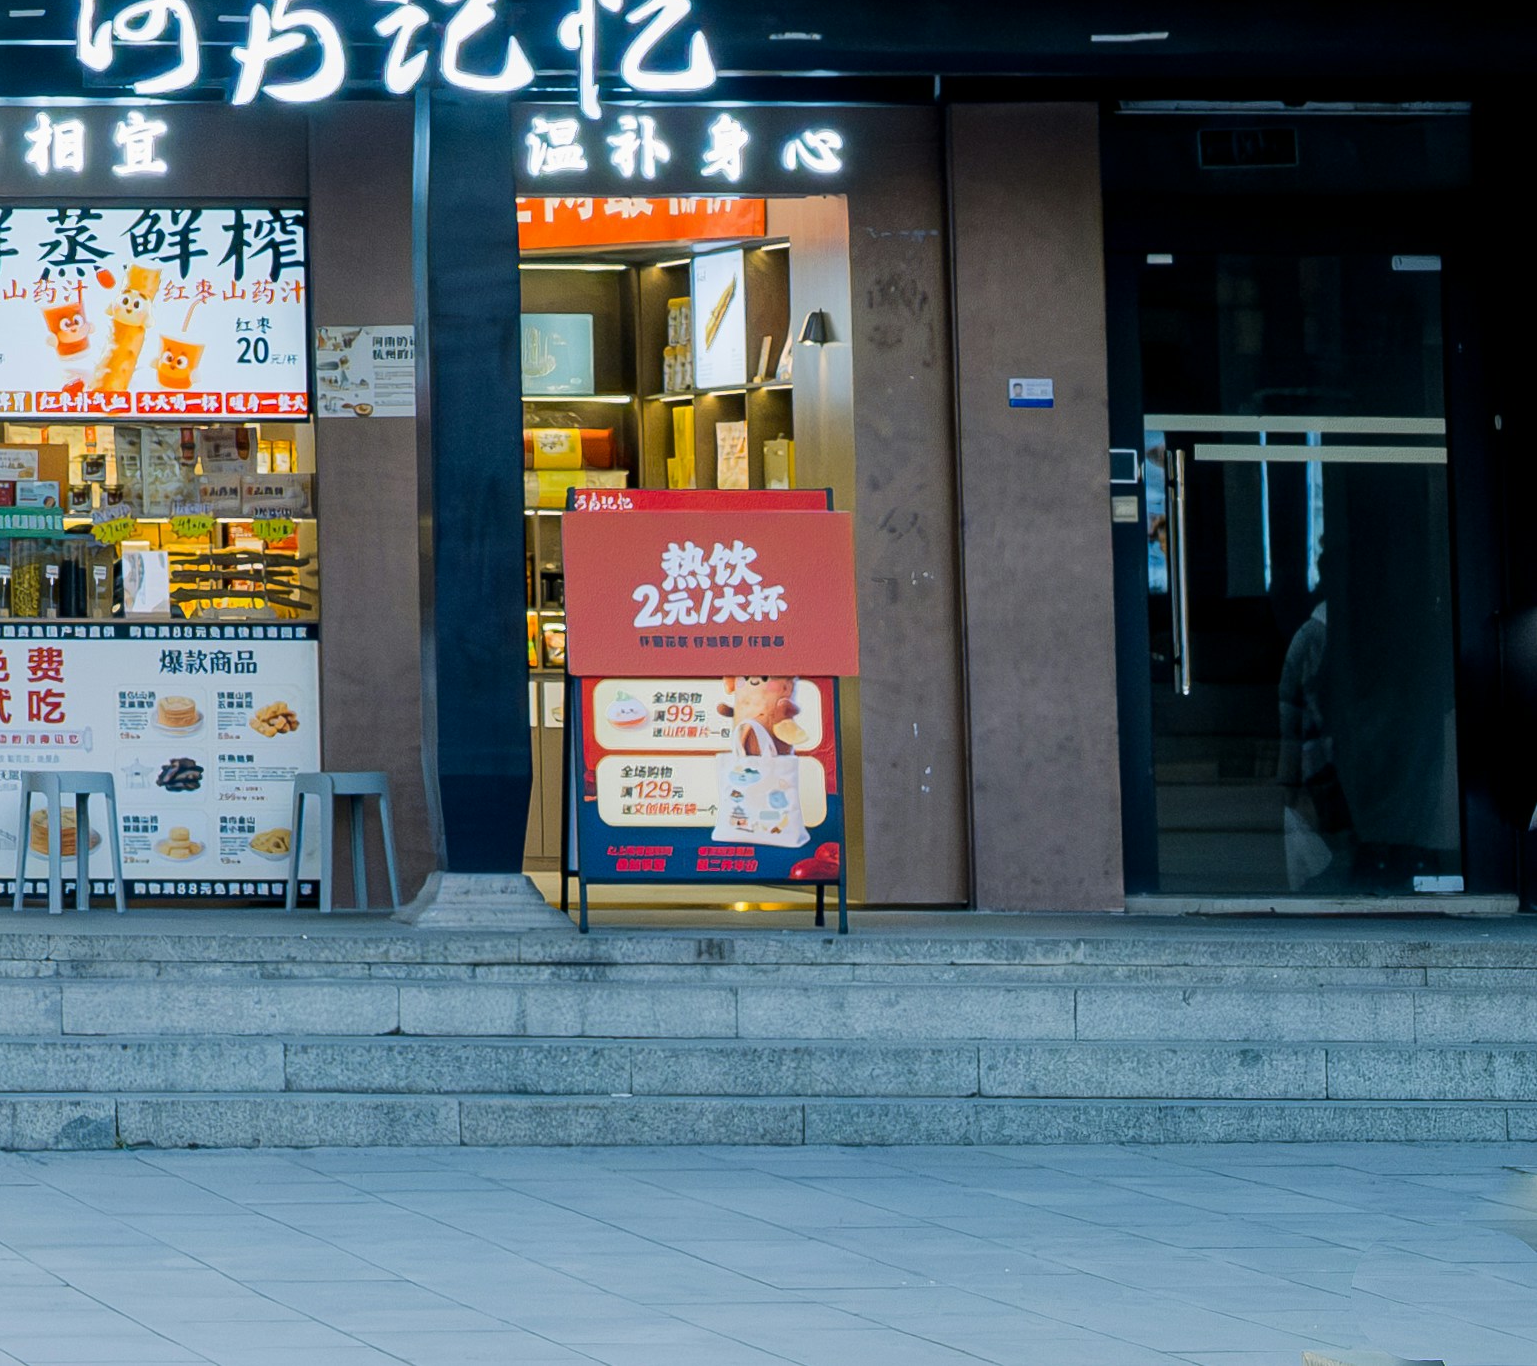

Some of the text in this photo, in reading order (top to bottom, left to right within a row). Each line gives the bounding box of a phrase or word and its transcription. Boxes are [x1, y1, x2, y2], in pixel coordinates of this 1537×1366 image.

[525, 113, 846, 181] 温补身心
[163, 279, 306, 305] 红枣山药汁
[660, 539, 764, 592] 热饮
[631, 583, 789, 628] 2元/大杯
[158, 649, 258, 675] 爆款商品
